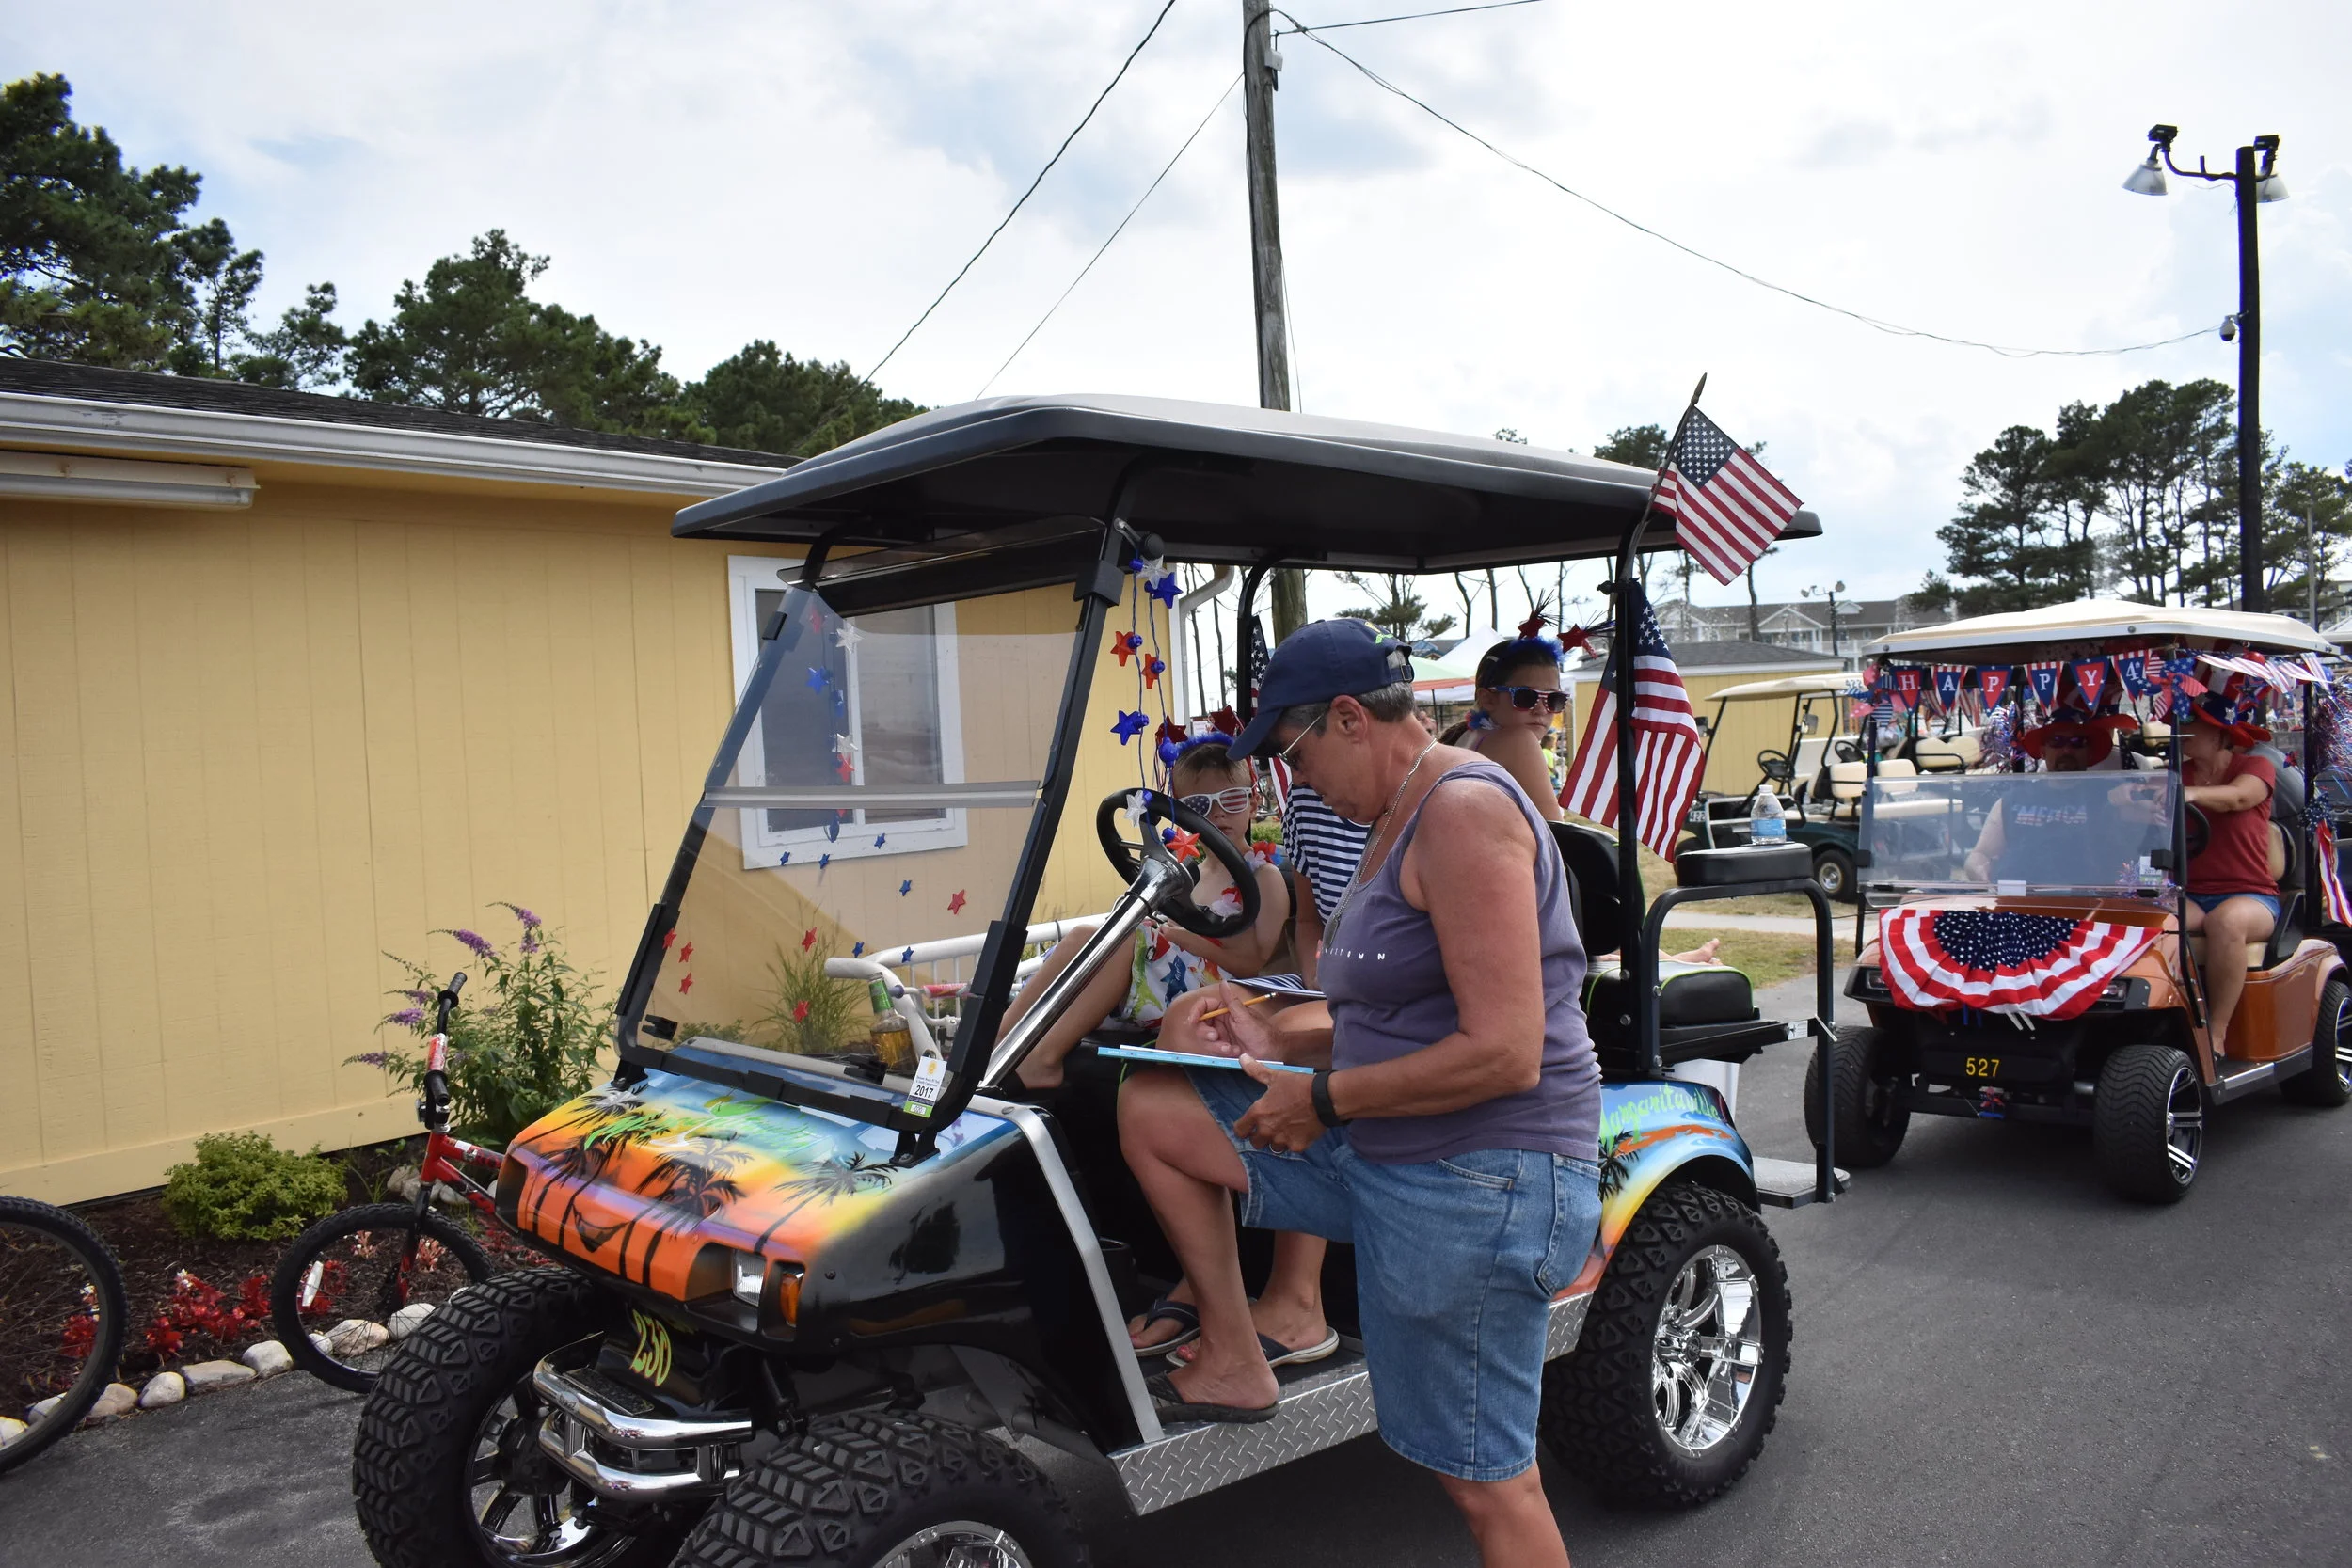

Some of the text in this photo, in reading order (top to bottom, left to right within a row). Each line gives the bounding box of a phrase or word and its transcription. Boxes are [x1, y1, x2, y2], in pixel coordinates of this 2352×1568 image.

[1965, 1057, 2001, 1078] 527
[914, 1085, 934, 1099] 2017
[629, 1308, 672, 1387] 230
